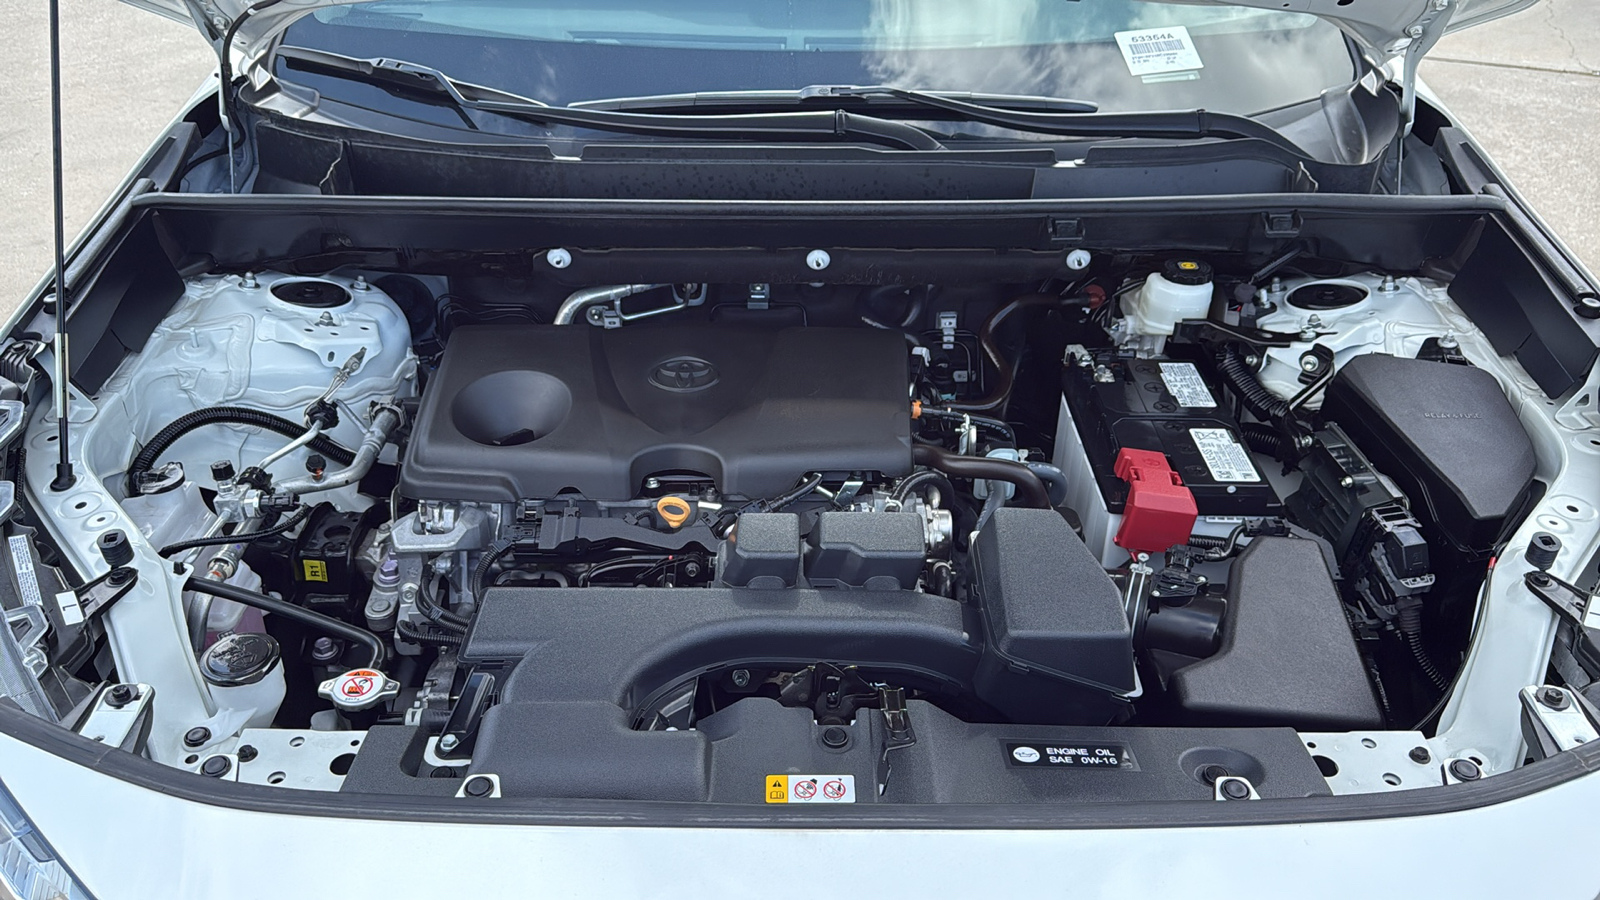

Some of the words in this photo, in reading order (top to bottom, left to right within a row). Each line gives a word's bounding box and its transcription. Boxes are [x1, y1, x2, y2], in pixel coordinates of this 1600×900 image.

[310, 565, 320, 577] R1
[1045, 747, 1089, 756] ENGINE
[1095, 748, 1115, 757] OIL
[1049, 756, 1073, 764] SAE
[1080, 756, 1118, 765] 0W-16
